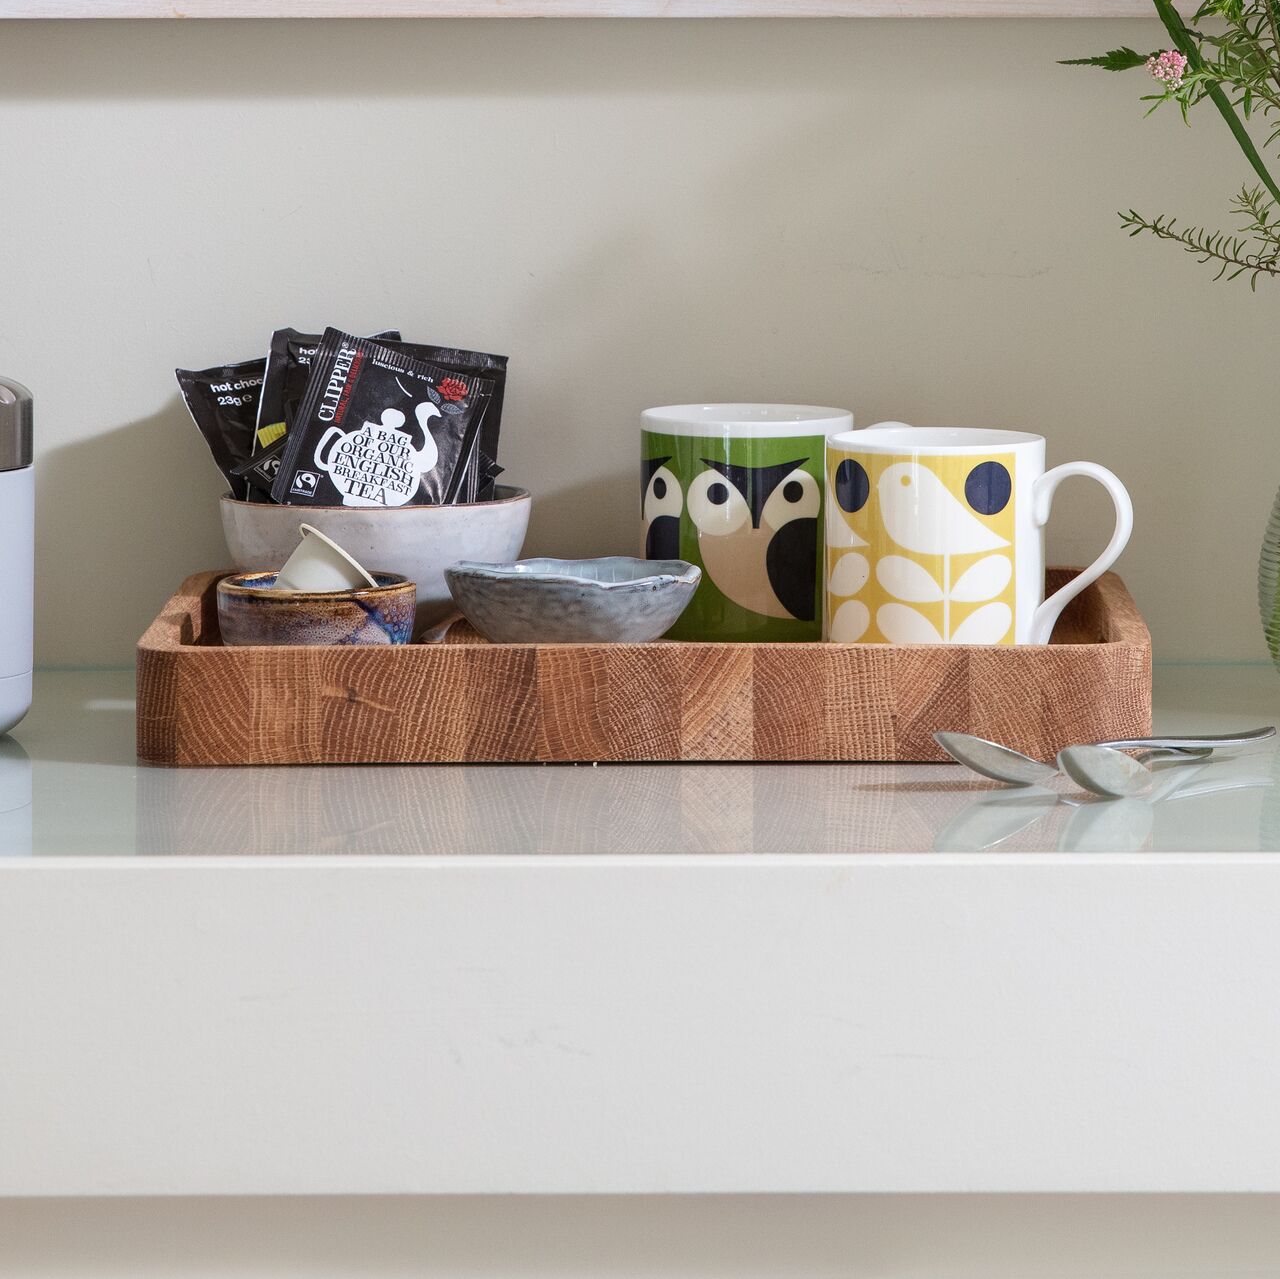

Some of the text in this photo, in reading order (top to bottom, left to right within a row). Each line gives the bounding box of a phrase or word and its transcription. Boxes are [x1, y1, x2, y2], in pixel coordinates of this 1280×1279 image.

[299, 347, 318, 355] ho
[372, 358, 405, 374] luscious
[417, 374, 434, 383] rich
[210, 382, 233, 393] hot
[318, 347, 357, 422] CLIPPER
[217, 395, 243, 406] 23g
[353, 434, 411, 461] OF OUR
[363, 426, 408, 447] A BAG
[332, 451, 414, 489] ENGLISH
[341, 441, 414, 475] ORGANIC
[333, 465, 412, 497] BREAKFAST
[344, 478, 387, 506] TEA
